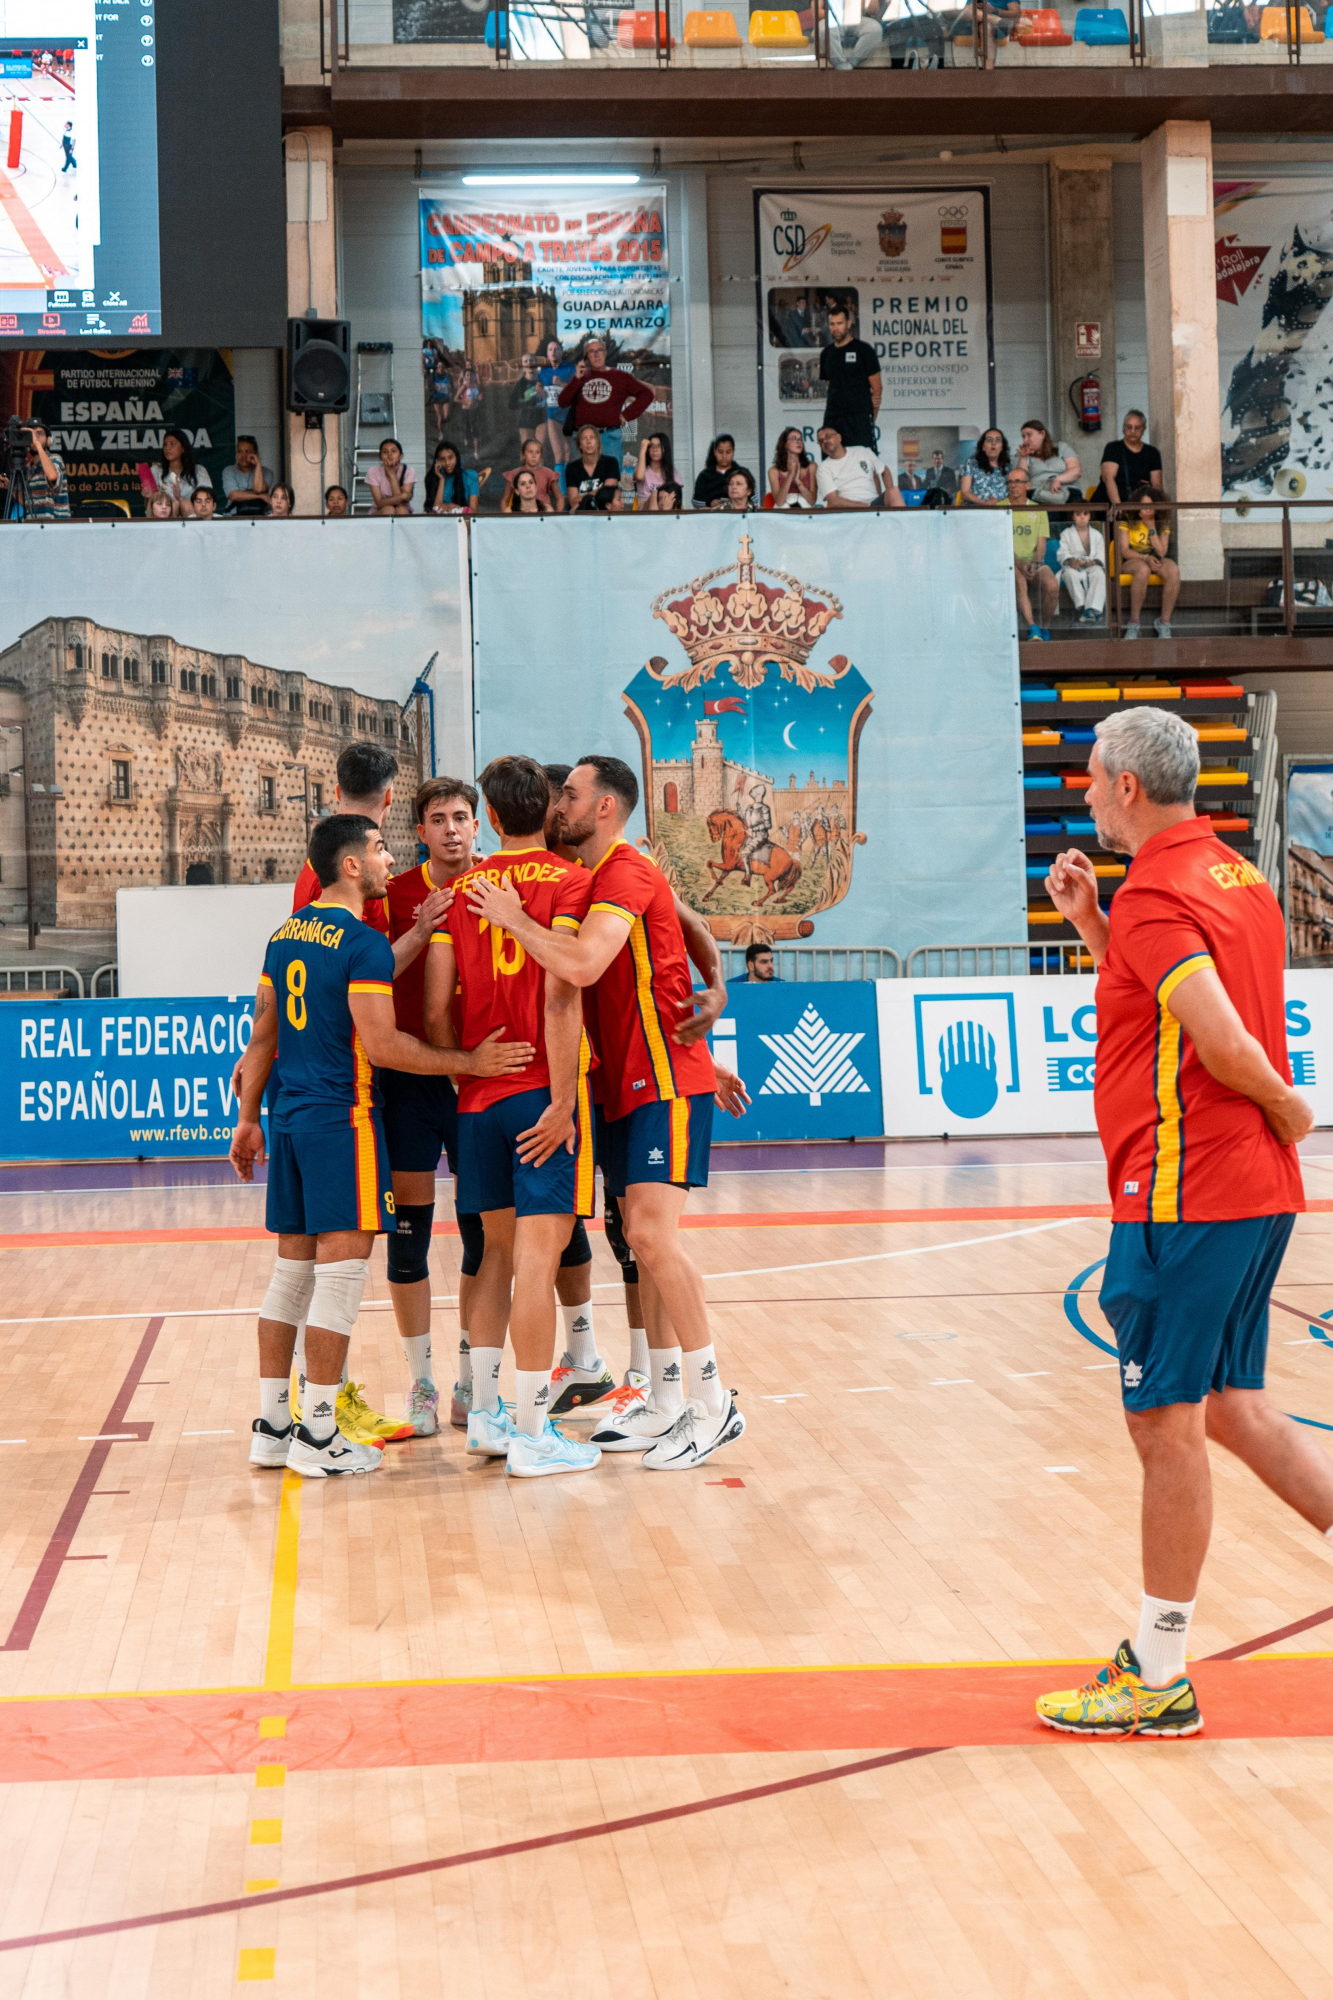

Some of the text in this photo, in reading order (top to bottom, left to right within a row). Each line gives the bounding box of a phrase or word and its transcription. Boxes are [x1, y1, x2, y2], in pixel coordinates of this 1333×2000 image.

[428, 206, 662, 237] CAMPEONATO DE ESPAÑA
[429, 235, 662, 263] DE CAMPO A TRAVÉS 2015
[773, 224, 806, 256] CSD
[1221, 249, 1245, 267] Roll
[563, 300, 664, 312] GUADALAJARA
[872, 296, 968, 314] PREMIO
[564, 316, 665, 330] 29 DE MARZO
[872, 318, 968, 336] NACIONAL DEL
[873, 340, 968, 358] DEPORTE
[60, 368, 161, 379] PARTIDO INTERNACIONAL
[921, 364, 969, 374] CONSEJO
[67, 379, 78, 388] DE
[114, 378, 156, 388] FEMENINO
[887, 376, 954, 385] SUPERIOR DE
[60, 395, 164, 422] ESPAÑA
[79, 481, 92, 491] de
[94, 481, 120, 491] 2015
[122, 483, 129, 491] a
[271, 917, 345, 950] LARRAÑAGA
[286, 959, 307, 1031] 8
[21, 1017, 91, 1059] REAL
[20, 1070, 165, 1122] ESPAÑOLA
[174, 1076, 209, 1118] DE
[384, 1191, 395, 1214] 8
[1154, 1622, 1186, 1633] luanvi
